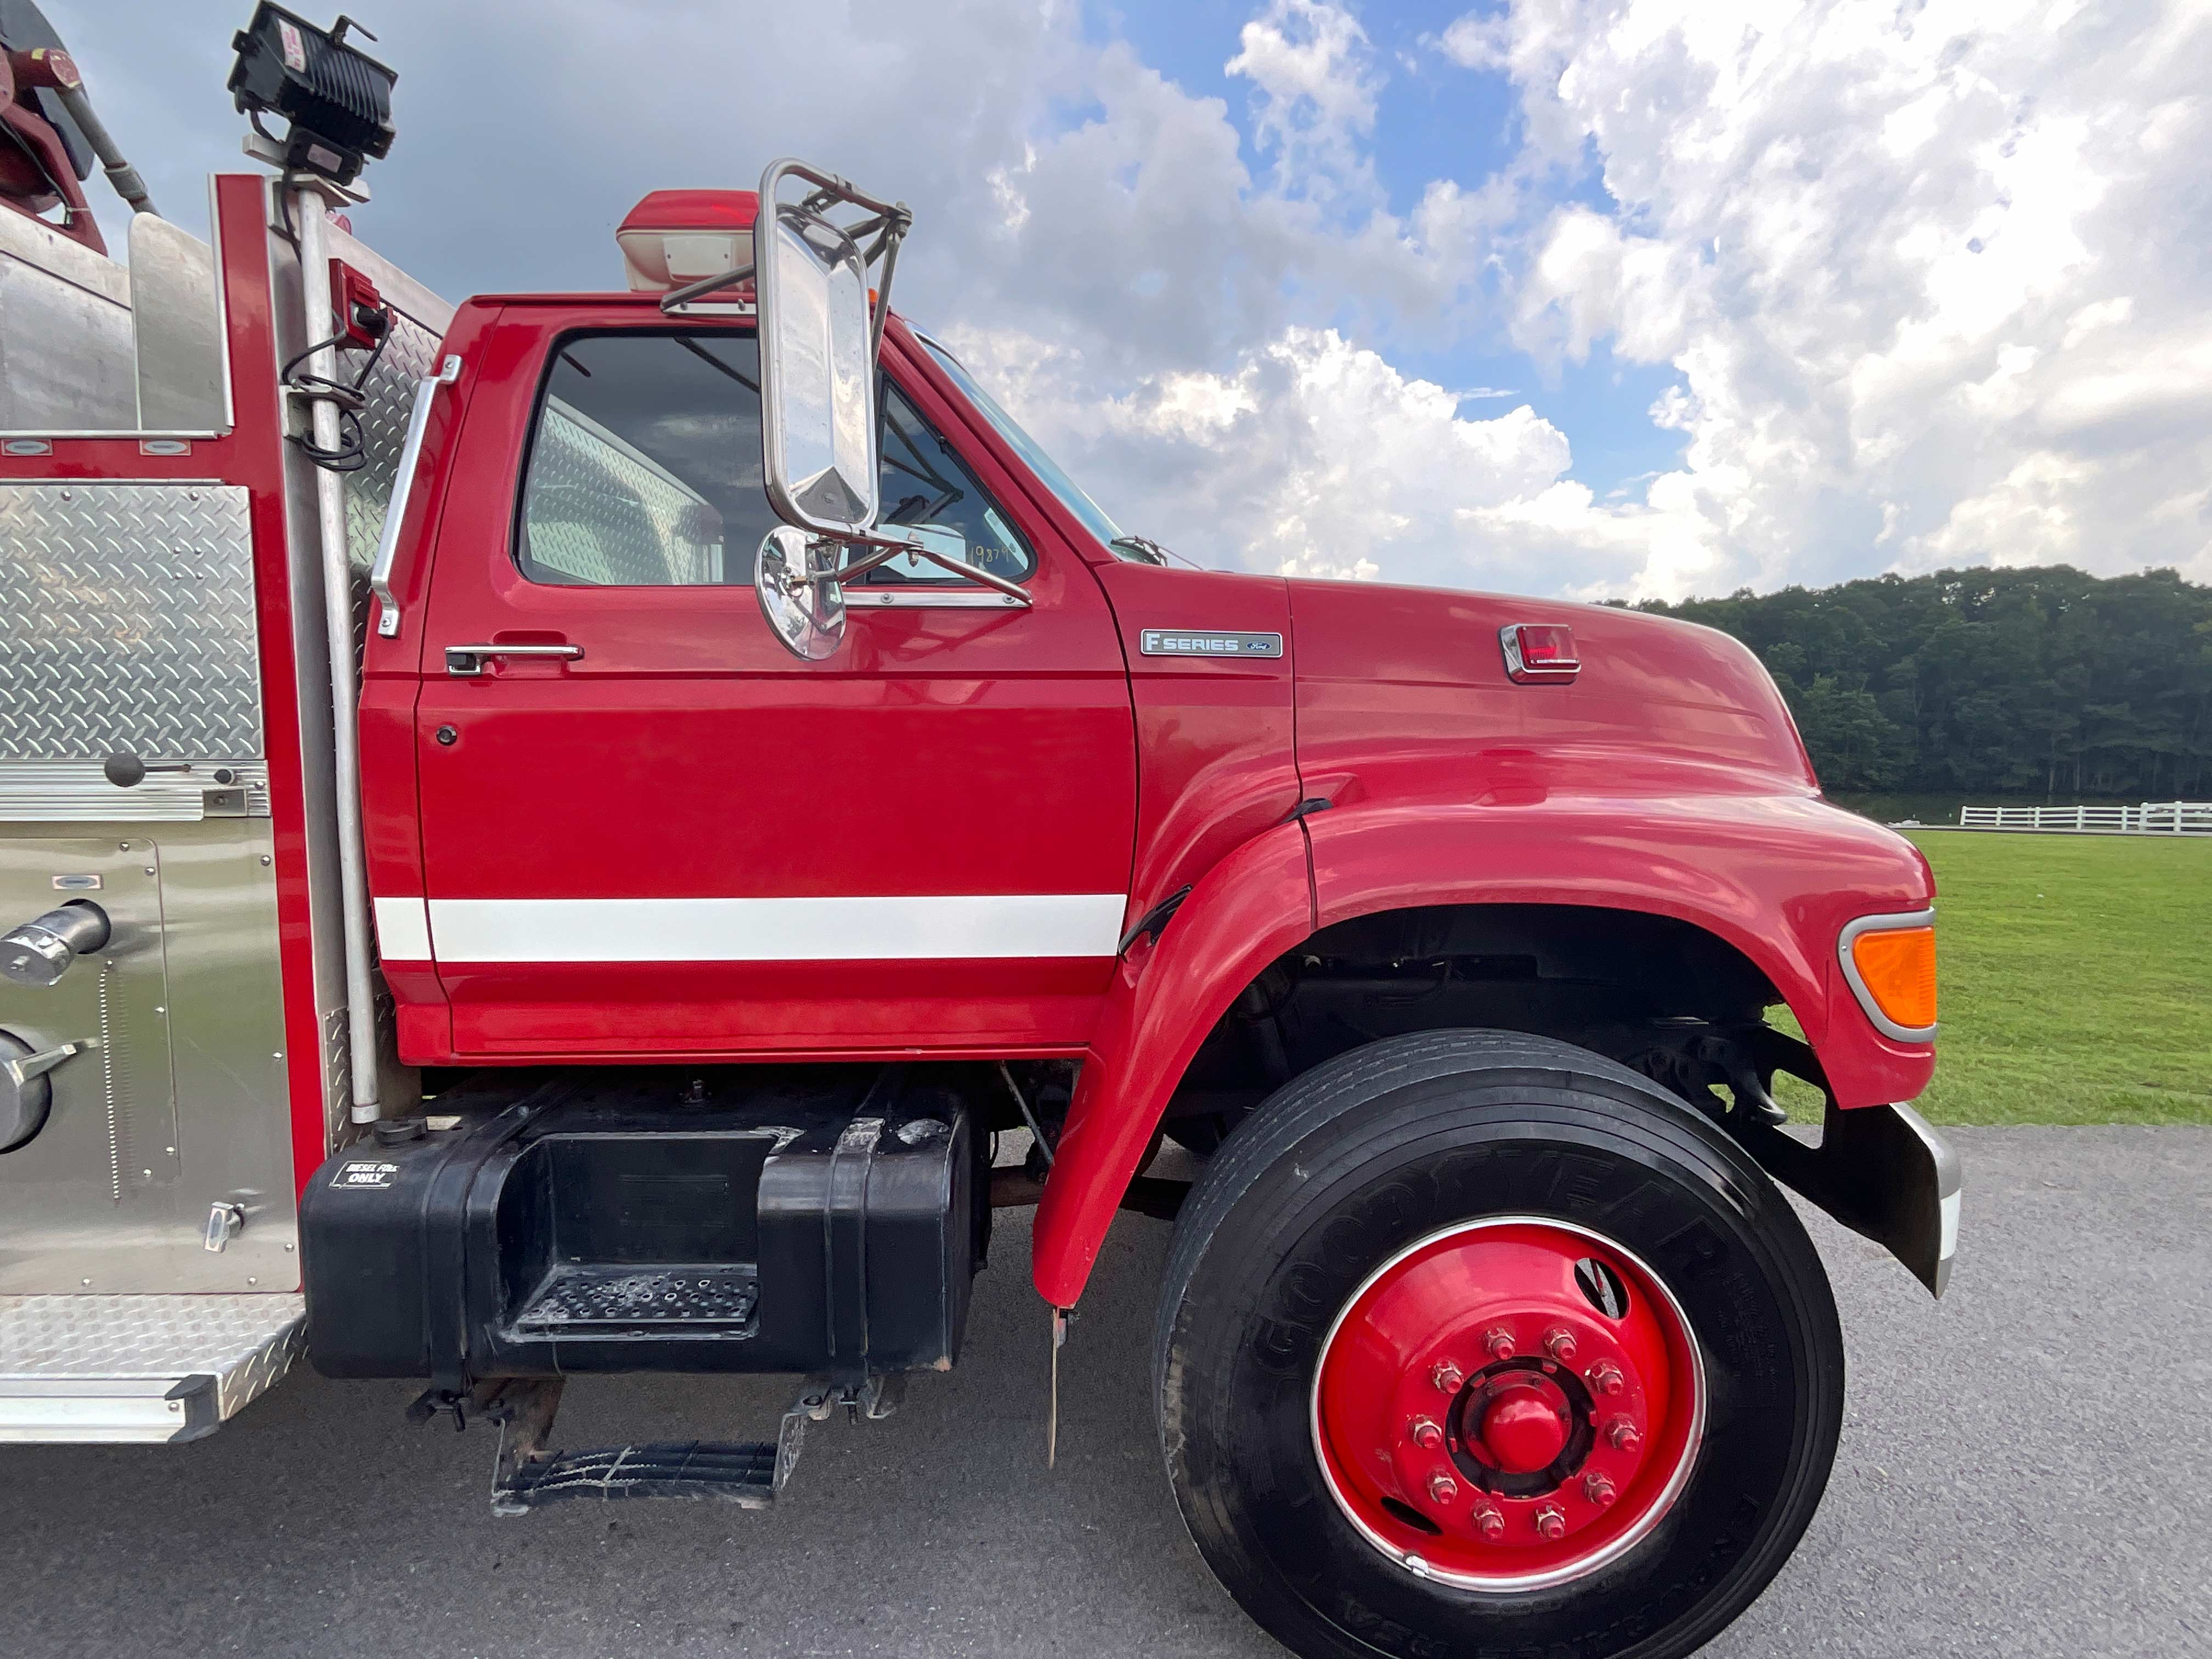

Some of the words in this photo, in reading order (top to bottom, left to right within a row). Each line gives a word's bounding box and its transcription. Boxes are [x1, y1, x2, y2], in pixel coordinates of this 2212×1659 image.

[1146, 633, 1160, 651] F
[1163, 639, 1239, 651] SERIES
[1249, 642, 1268, 650] Ford
[346, 1164, 377, 1172] DIESEL
[348, 1173, 386, 1183] ONLY
